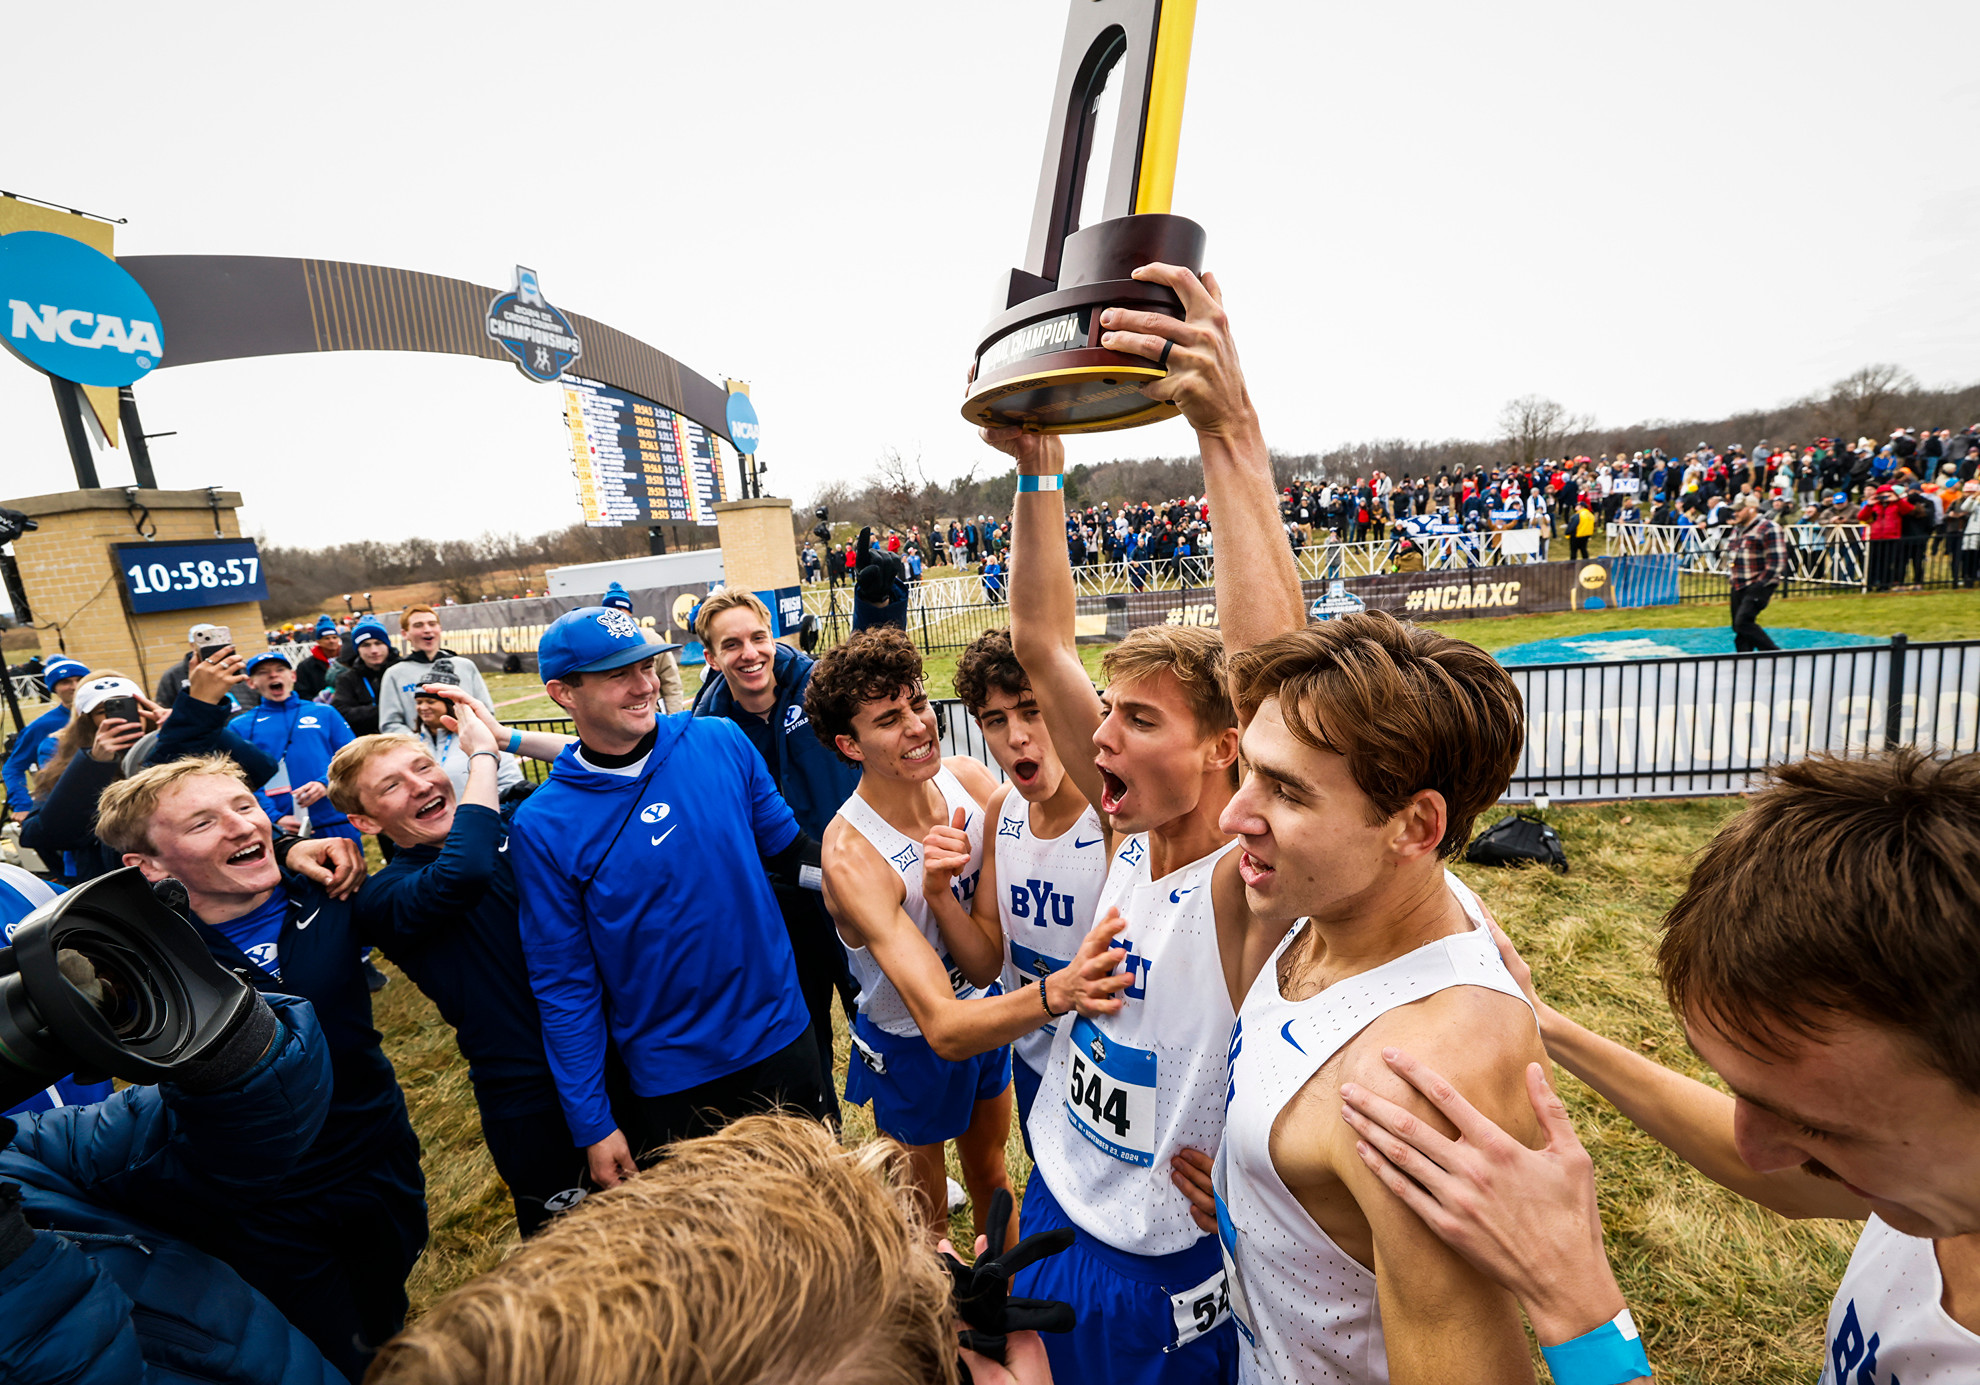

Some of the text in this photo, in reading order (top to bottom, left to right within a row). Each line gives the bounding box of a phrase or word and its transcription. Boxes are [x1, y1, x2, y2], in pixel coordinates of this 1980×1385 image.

[9, 299, 163, 358] NCAA
[489, 318, 579, 353] CHAMPIONSHIPS
[1011, 317, 1079, 356] CHAMPION
[730, 420, 760, 441] NCAA
[127, 557, 259, 594] 10:58:57
[779, 596, 801, 614] FINISH
[1405, 581, 1521, 611] #NCAAXC
[785, 611, 801, 628] LINE
[1011, 879, 1074, 927] BYU
[1071, 1054, 1130, 1137] 544
[1085, 1129, 1109, 1151] NOVEMBER
[1120, 1151, 1139, 1162] 2024
